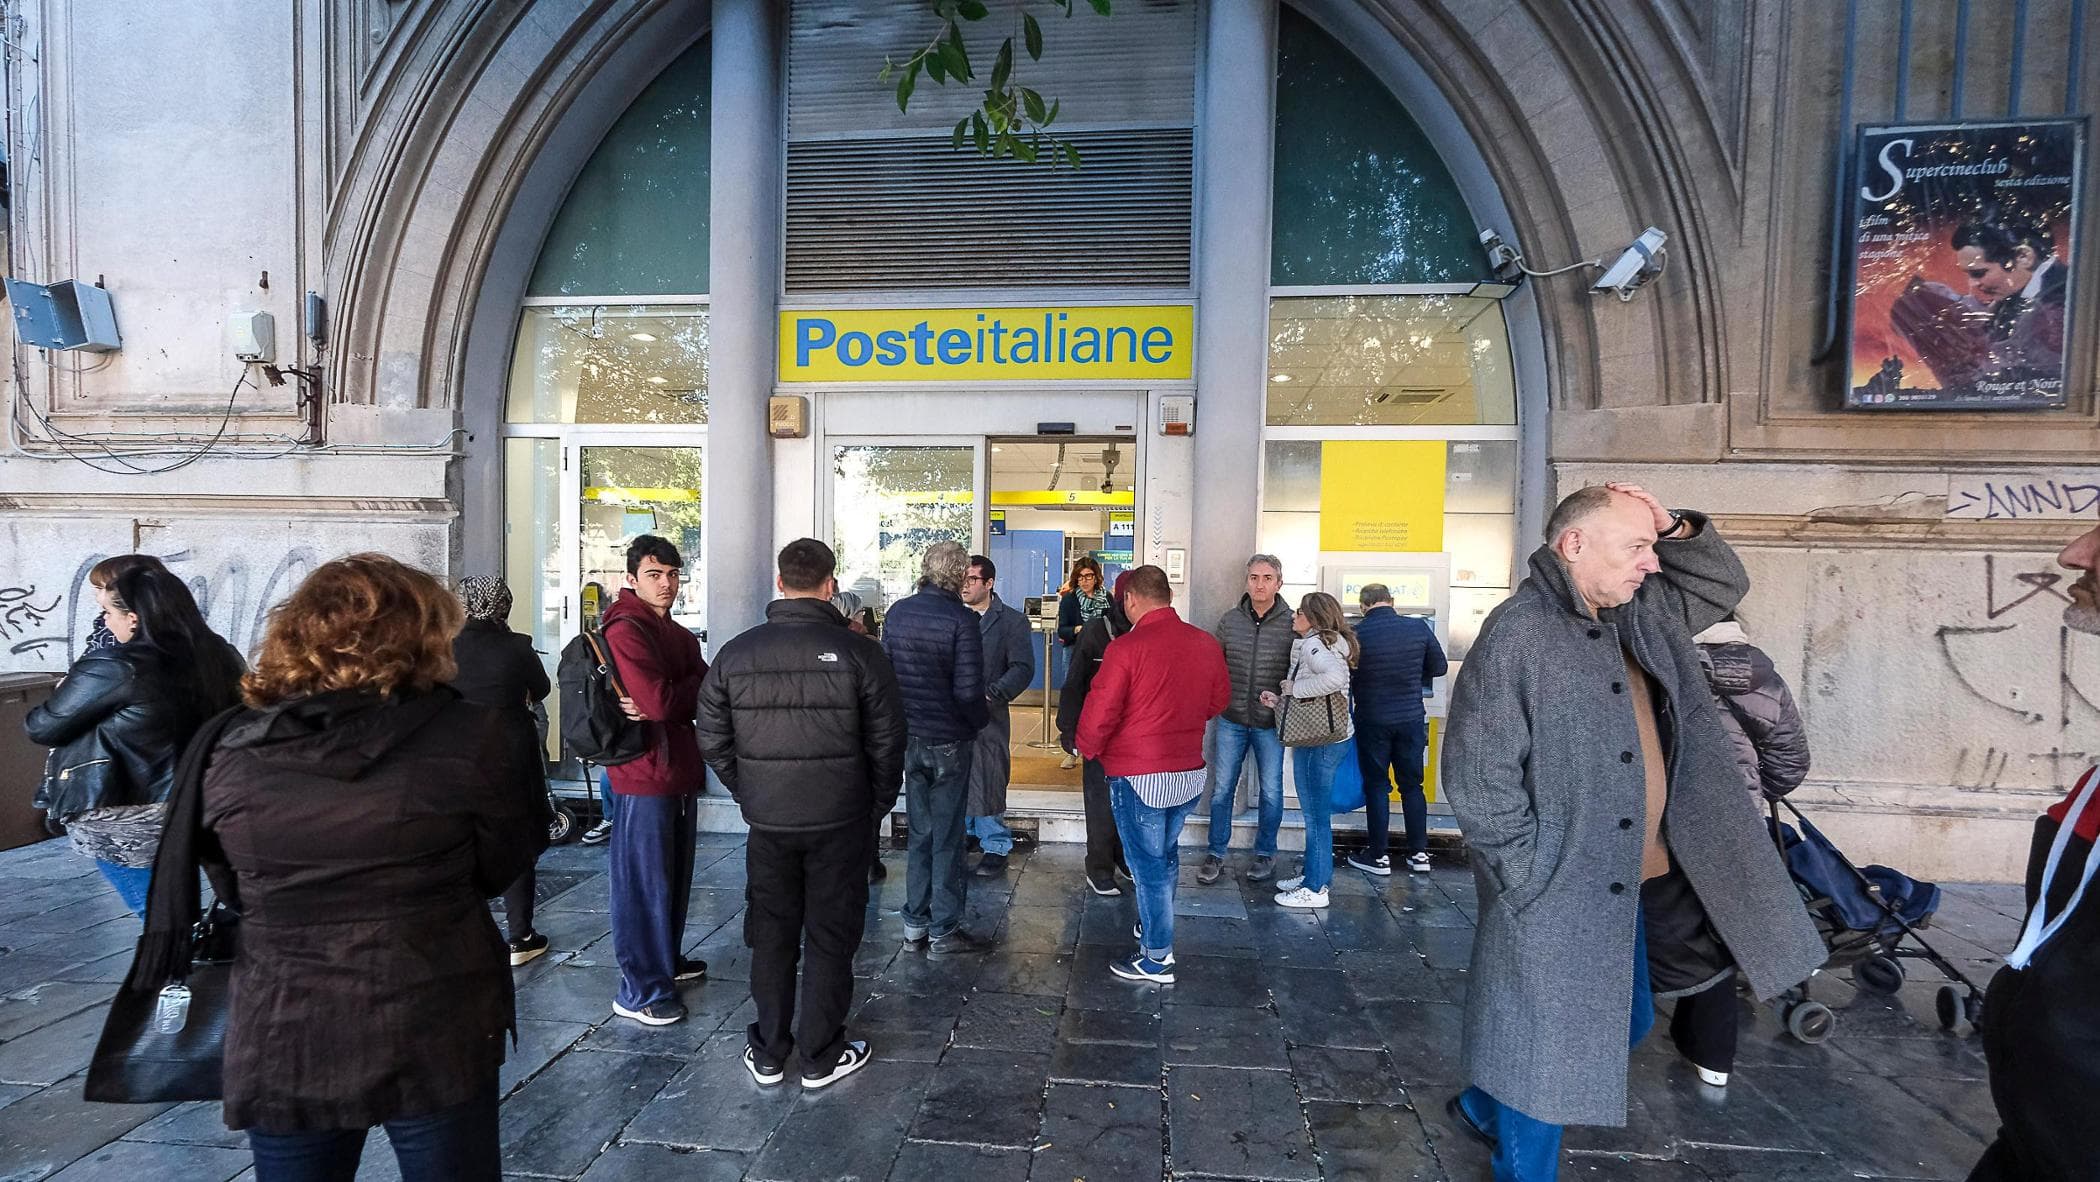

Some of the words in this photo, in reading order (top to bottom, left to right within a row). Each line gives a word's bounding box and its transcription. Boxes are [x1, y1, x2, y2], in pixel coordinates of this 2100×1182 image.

[1861, 139, 2007, 201] Supercineclub
[2023, 174, 2070, 186] edizione
[1872, 234, 1893, 242] una
[796, 312, 1173, 367] Posteitaliane
[1975, 380, 2013, 394] Rouge
[2014, 381, 2026, 391] et
[1069, 492, 1077, 501] 5
[1346, 585, 1407, 595] POAT
